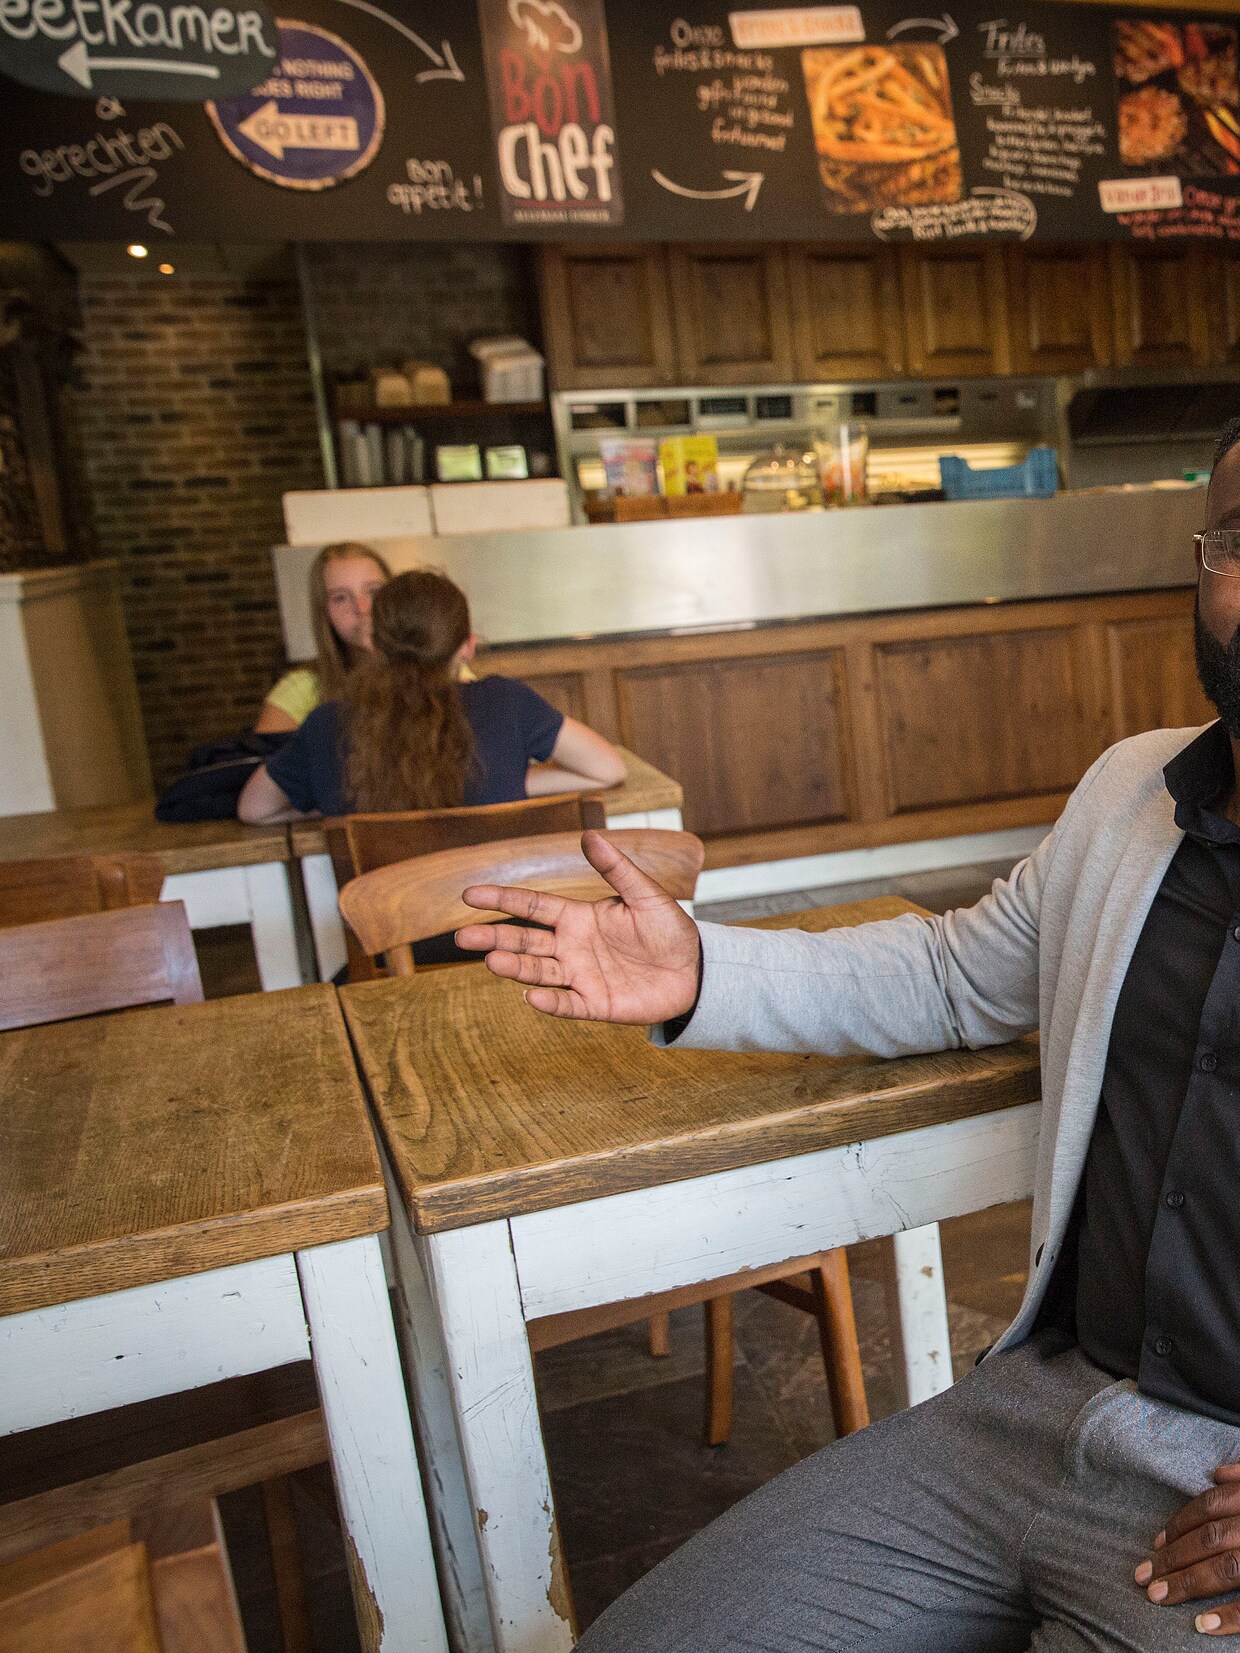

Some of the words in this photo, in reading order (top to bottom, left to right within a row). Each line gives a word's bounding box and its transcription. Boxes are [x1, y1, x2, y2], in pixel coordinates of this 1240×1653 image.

[19, 121, 185, 197] gerechten
[254, 117, 292, 141] GO
[295, 121, 350, 143] LEFT
[498, 121, 615, 202] Chef
